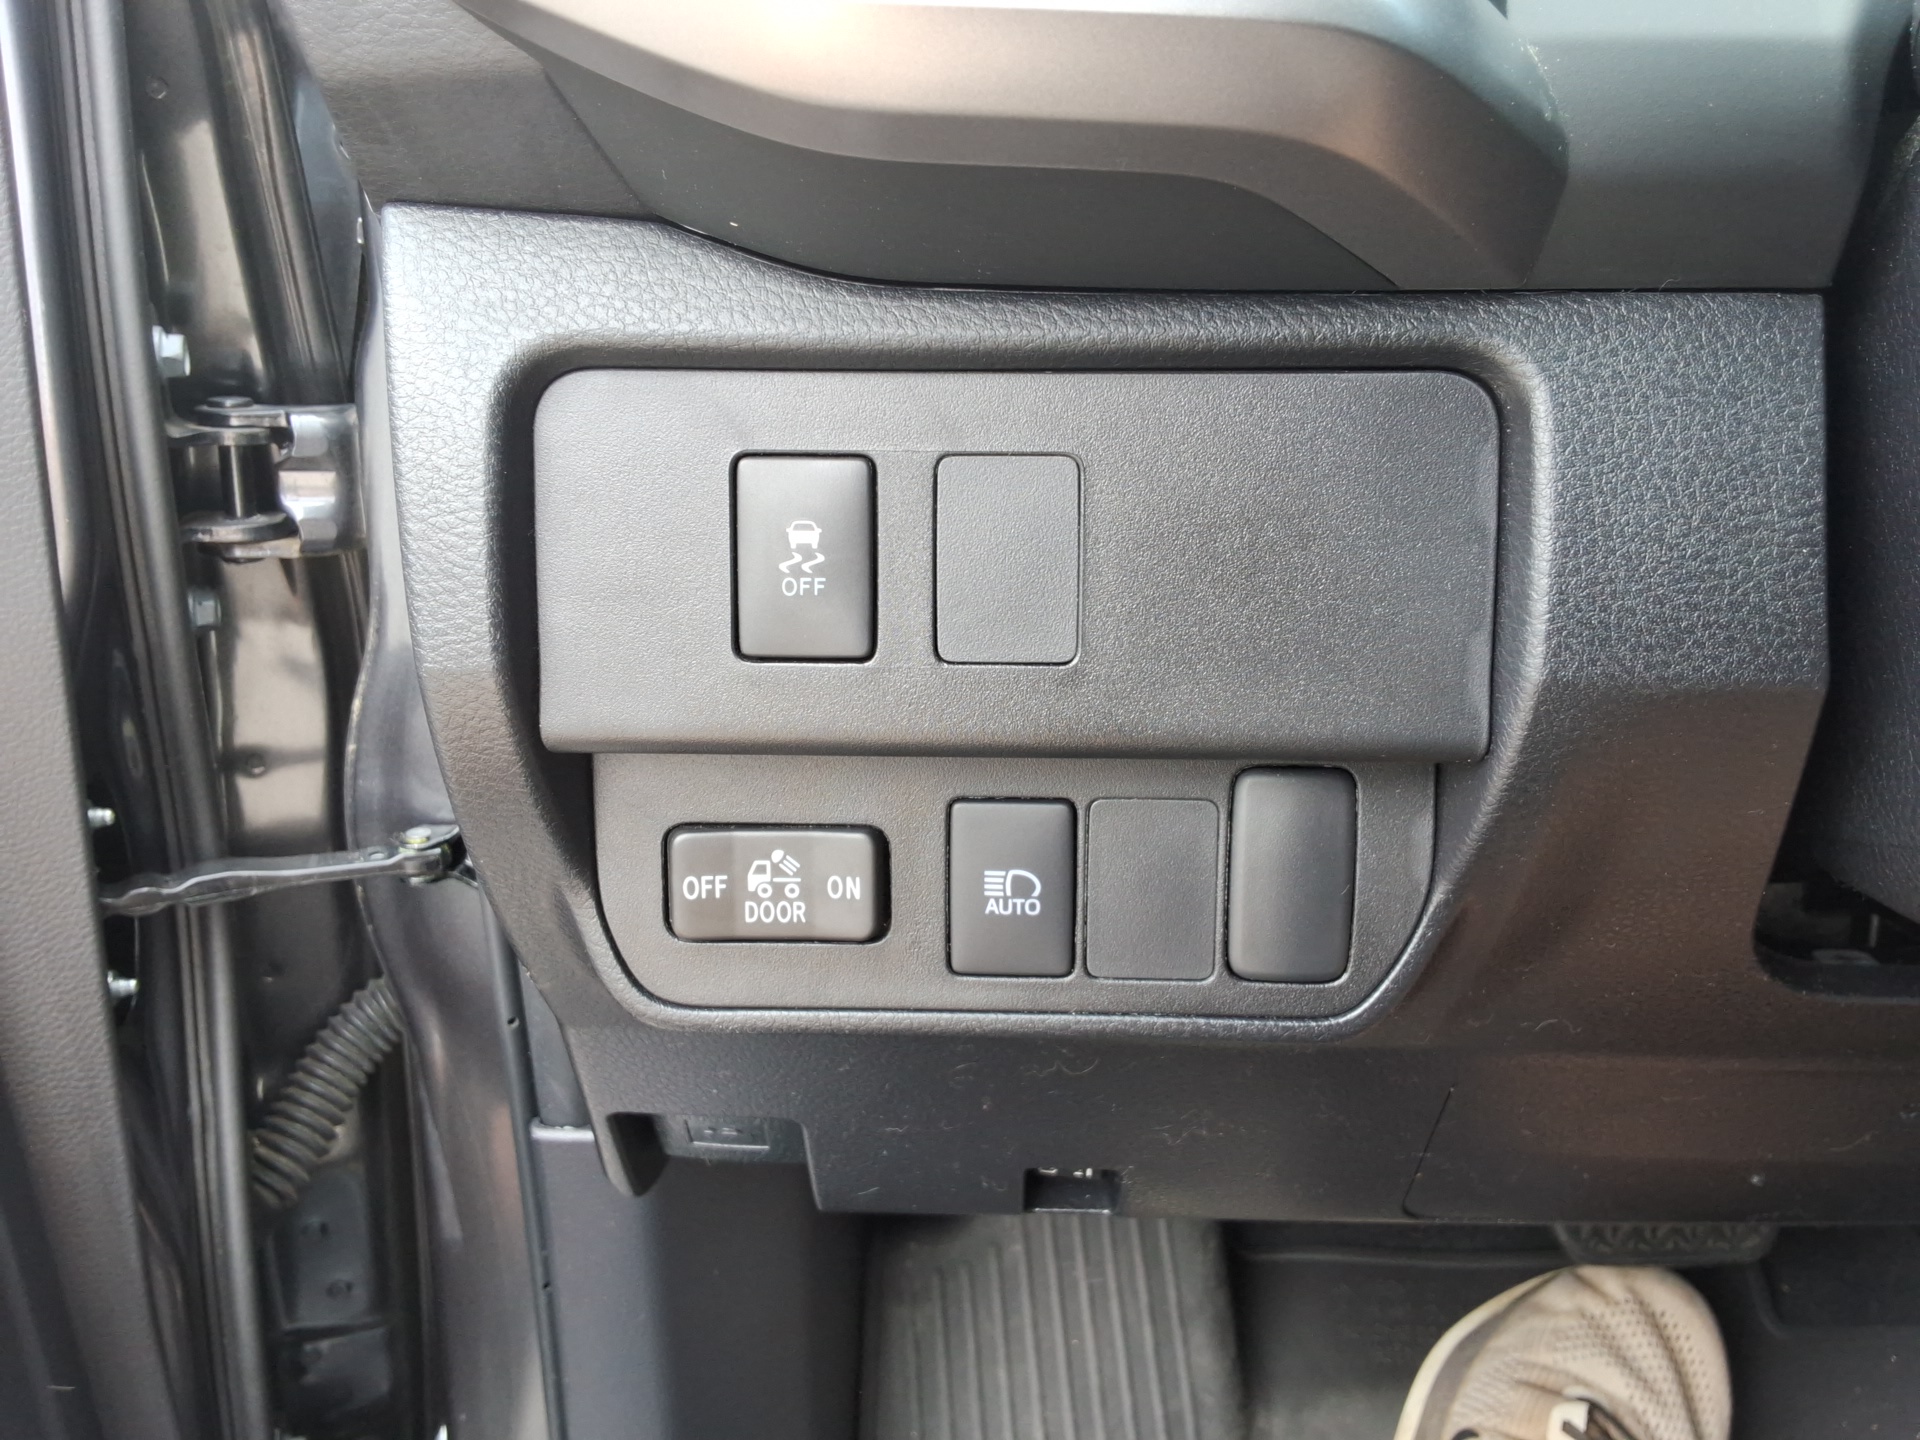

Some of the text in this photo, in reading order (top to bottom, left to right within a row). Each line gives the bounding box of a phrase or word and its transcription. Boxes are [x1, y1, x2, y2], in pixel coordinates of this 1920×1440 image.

[781, 577, 826, 597] OFF
[682, 874, 728, 900] OFF
[826, 875, 861, 900] ON
[744, 901, 806, 924] DOOR
[984, 898, 1041, 916] AUTO
